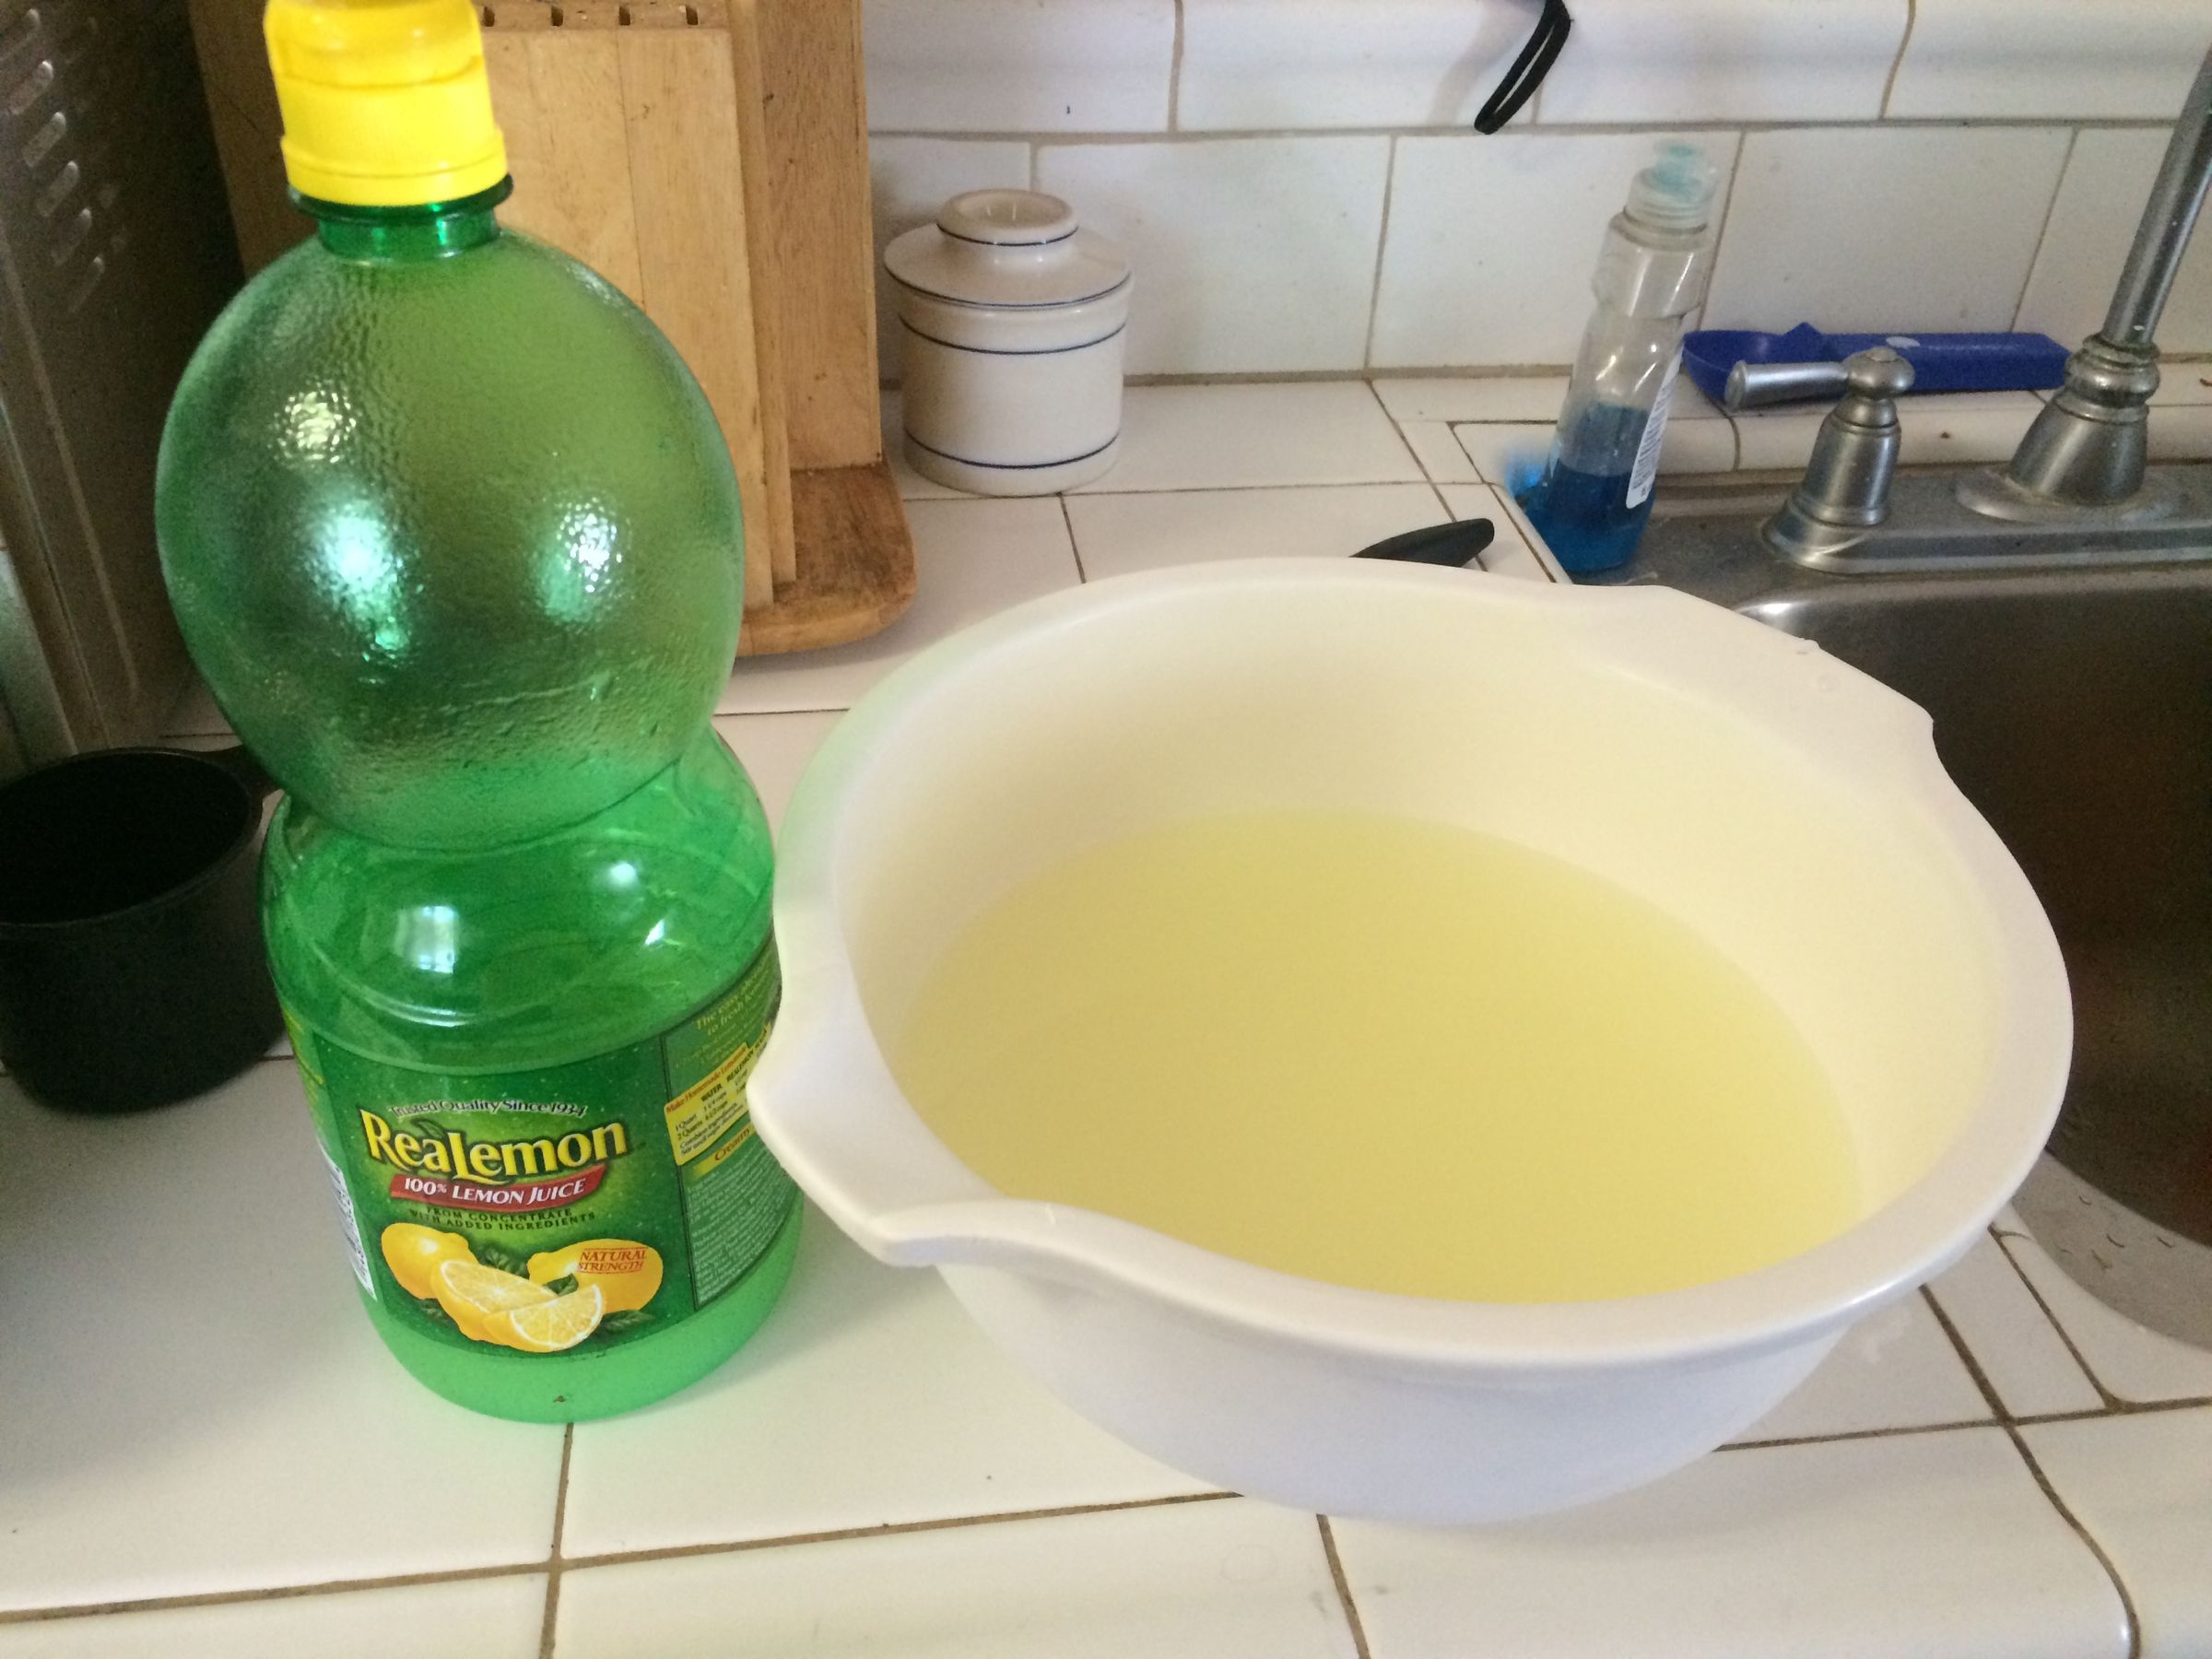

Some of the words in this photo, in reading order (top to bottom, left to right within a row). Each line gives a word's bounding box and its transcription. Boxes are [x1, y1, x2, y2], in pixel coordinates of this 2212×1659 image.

[700, 1083, 723, 1101] WATER
[391, 1100, 437, 1118] Trusted
[440, 1100, 500, 1115] Quality
[503, 1100, 548, 1112] Since
[550, 1102, 588, 1119] 1934
[359, 1109, 628, 1185] ReaLemon
[404, 1177, 447, 1196] 100%
[453, 1185, 524, 1205] LEMON
[526, 1178, 586, 1206] JUICE
[409, 1208, 441, 1224] WITH
[446, 1217, 493, 1230] ADDED
[498, 1211, 595, 1231] INGREDIENTS
[427, 1206, 462, 1219] FROM
[468, 1207, 572, 1224] CONCENTRATE
[580, 1250, 647, 1262] NATURAL
[578, 1261, 643, 1272] STRENGTH
